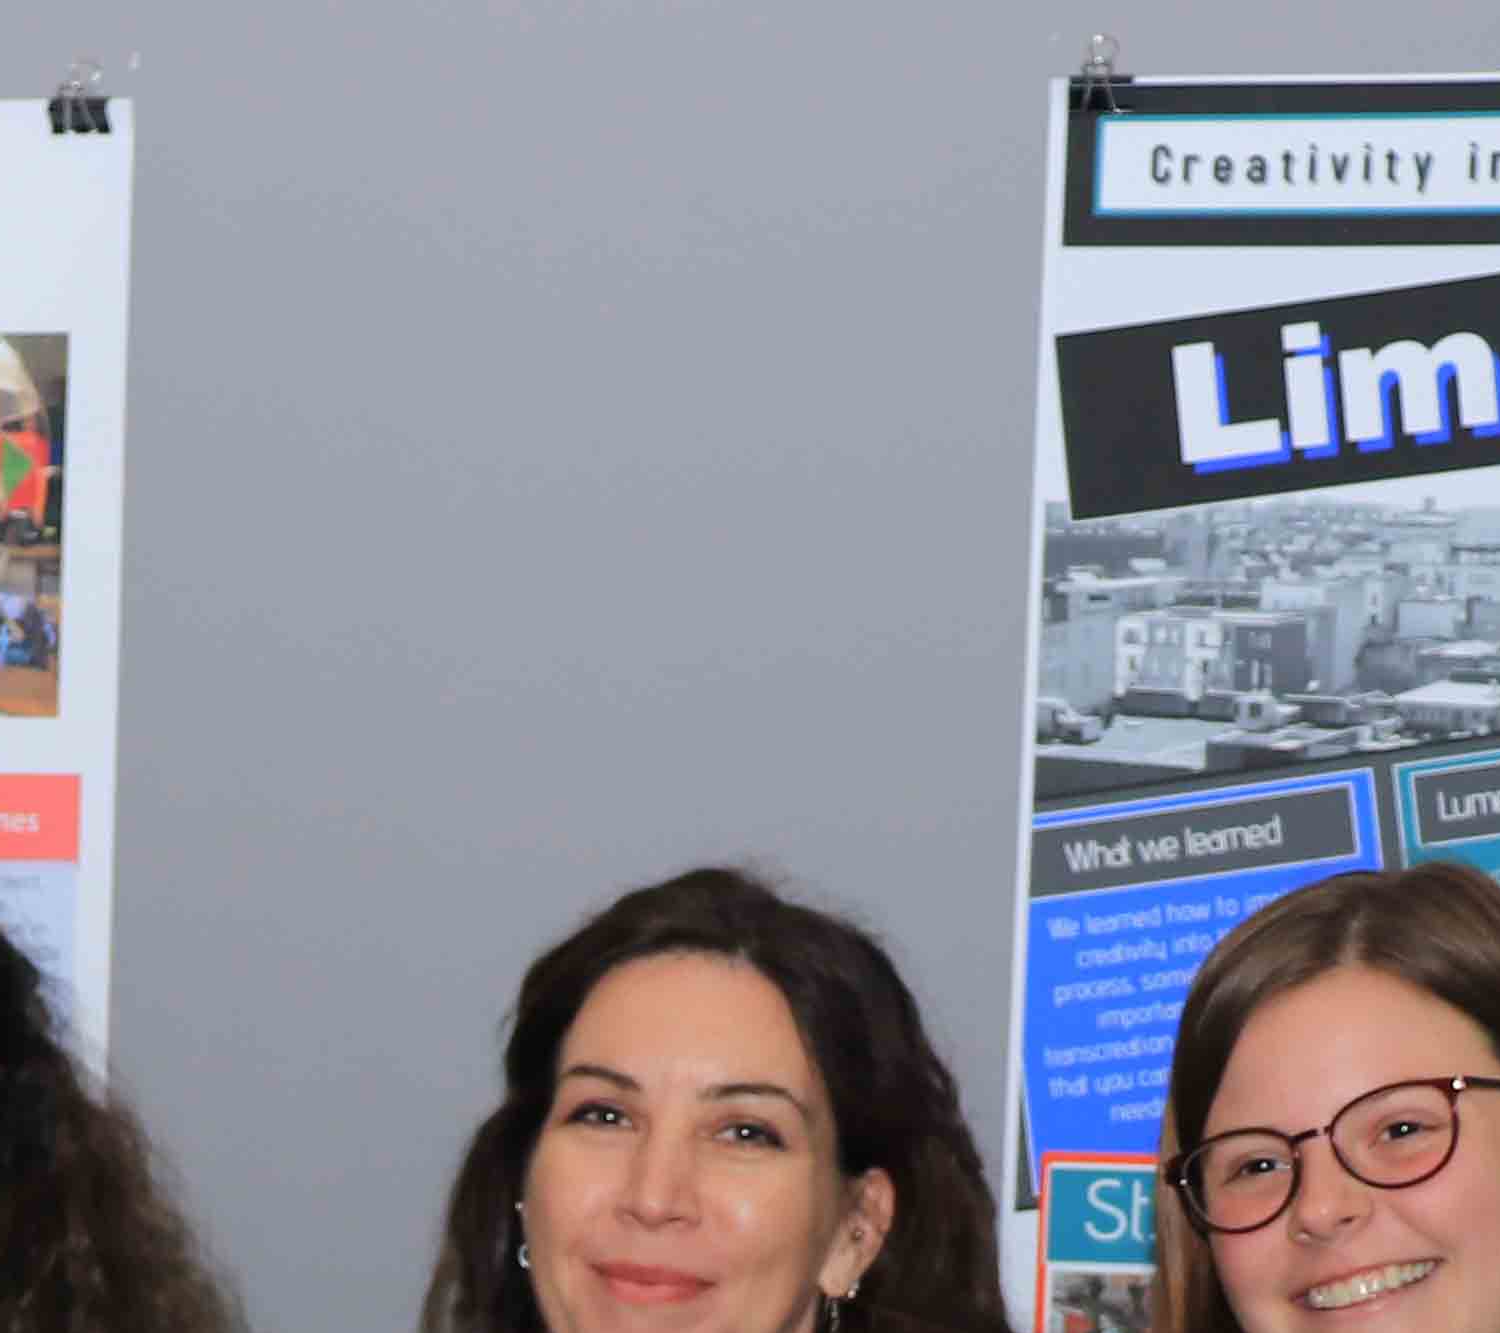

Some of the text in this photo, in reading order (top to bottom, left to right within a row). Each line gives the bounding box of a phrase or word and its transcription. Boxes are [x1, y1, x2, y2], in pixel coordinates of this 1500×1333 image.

[1148, 139, 1437, 190] Creativity
[1062, 814, 1283, 873] What we learned
[1046, 916, 1080, 940] We
[1084, 905, 1162, 934] learned
[1165, 903, 1211, 923] how
[1215, 896, 1241, 918] to
[1076, 937, 1168, 968] creativity
[1048, 1074, 1088, 1098] that
[1093, 1071, 1134, 1096] you
